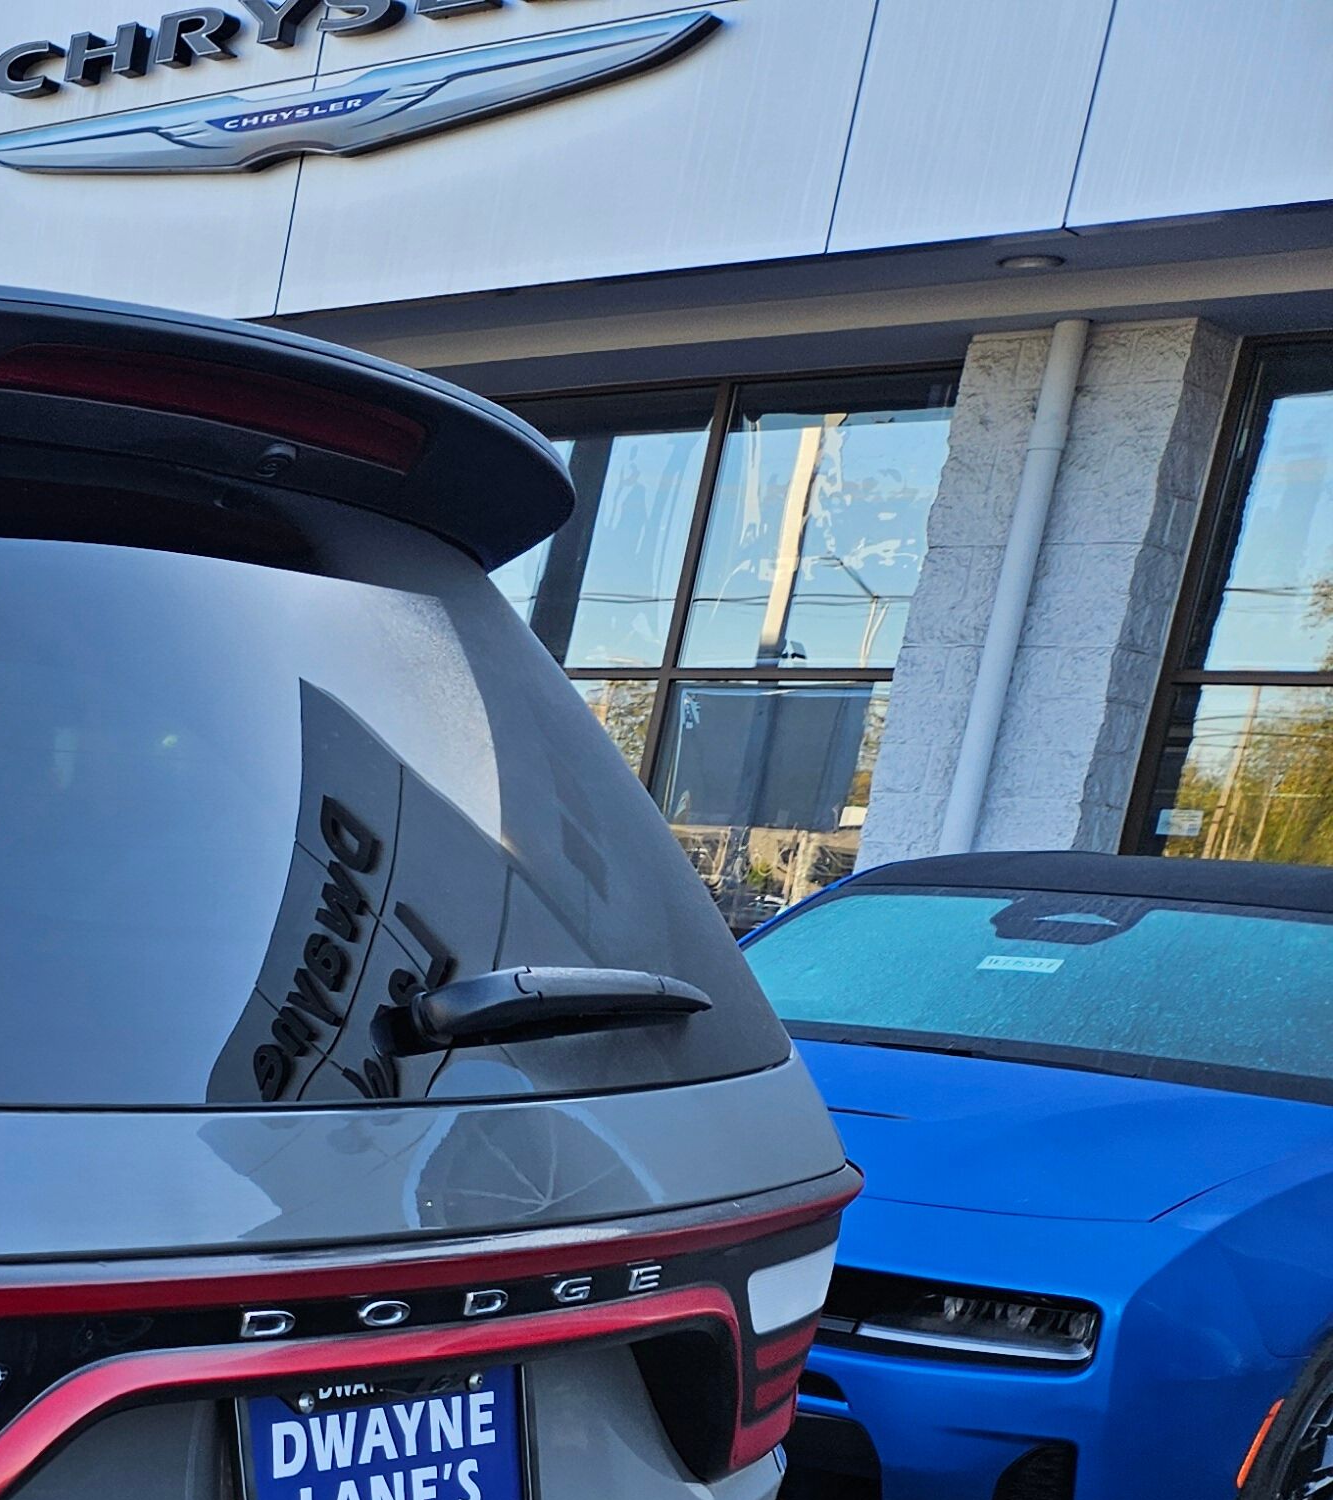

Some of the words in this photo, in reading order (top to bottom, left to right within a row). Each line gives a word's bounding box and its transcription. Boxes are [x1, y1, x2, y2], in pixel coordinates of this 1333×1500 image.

[223, 98, 363, 130] CHRYSLER
[239, 1264, 663, 1339] DODGE
[271, 1391, 496, 1479] DWAYNE
